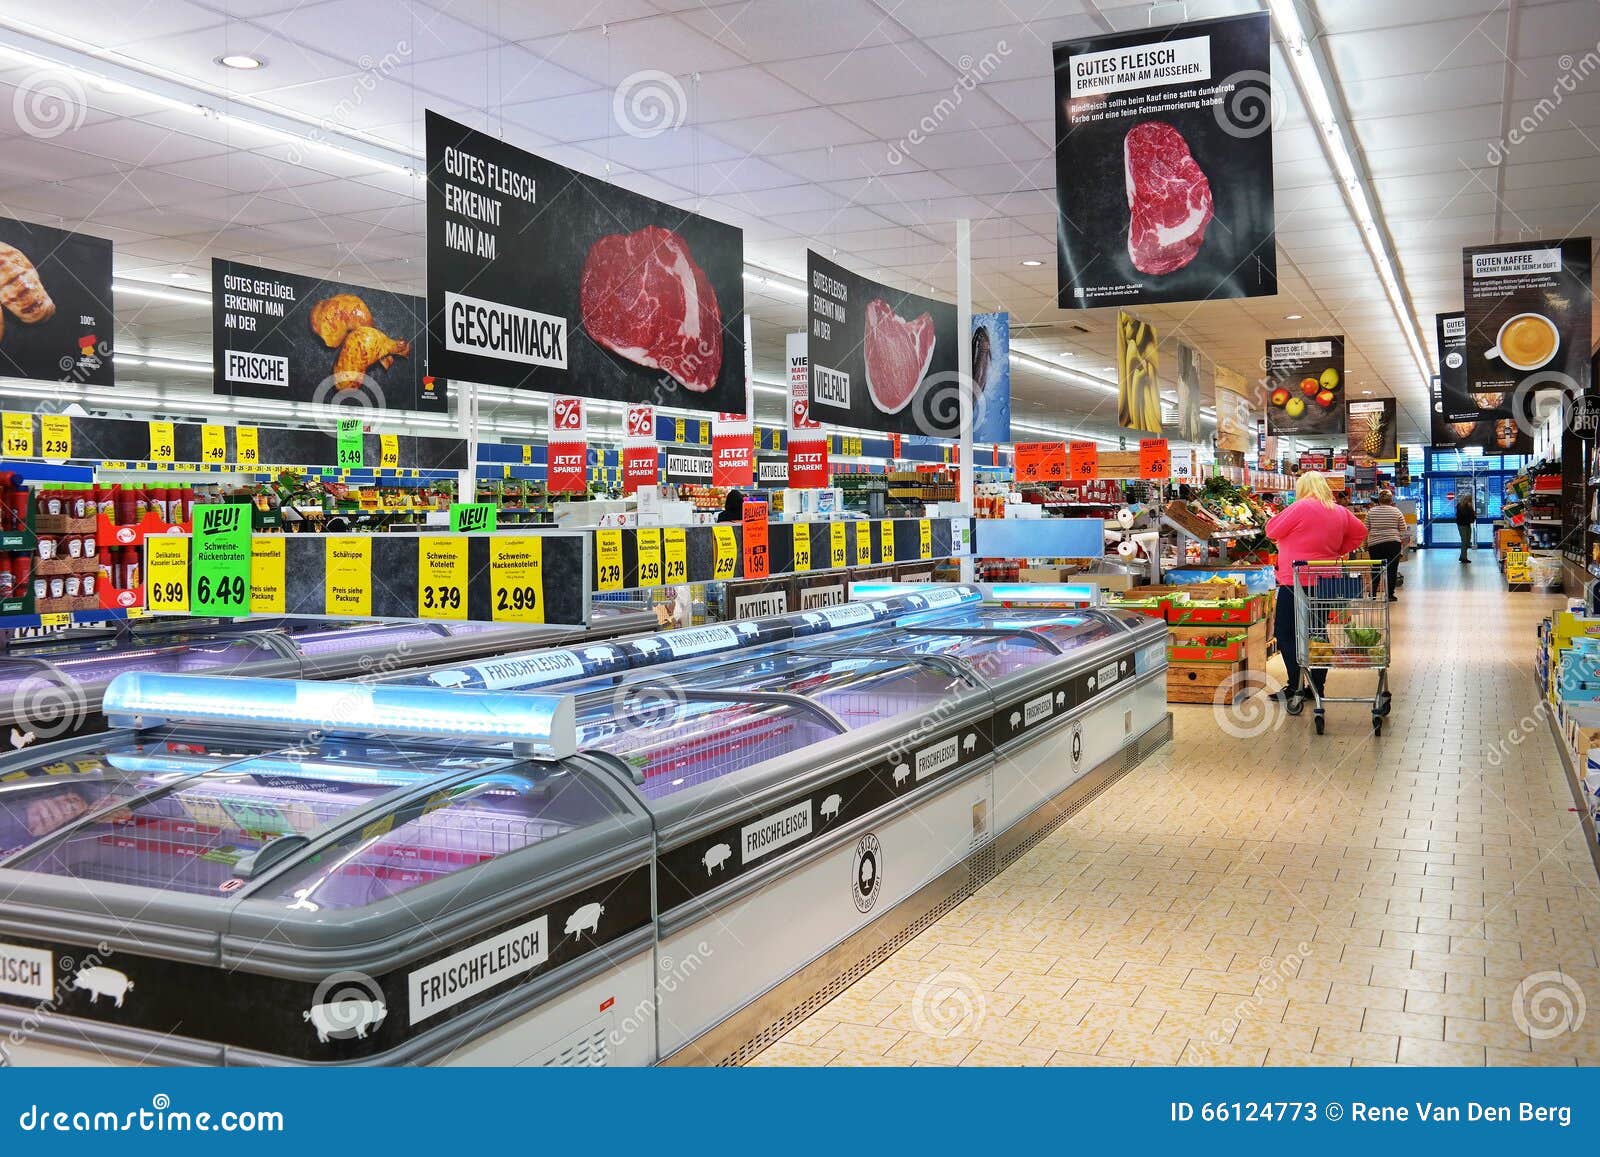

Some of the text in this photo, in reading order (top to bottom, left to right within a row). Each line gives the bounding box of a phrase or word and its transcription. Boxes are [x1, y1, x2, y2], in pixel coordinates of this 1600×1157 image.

[1077, 49, 1175, 77] GUTES FLEISCH
[1077, 63, 1203, 90] ERKENNT MAN AM AUSSEHEN.
[1109, 98, 1127, 108] sollte
[1128, 96, 1145, 105] beim
[1146, 93, 1162, 103] Kauf
[1163, 92, 1178, 100] eine
[1179, 89, 1197, 98] satte
[1071, 113, 1091, 123] Farbe
[1091, 111, 1104, 121] und
[1105, 110, 1119, 119] eine
[445, 147, 536, 204] GUTES FLEISCH
[446, 183, 501, 226] ERKENNT
[446, 221, 495, 260] MAN AM
[1476, 255, 1533, 266] GUTEN KAFFEE
[224, 274, 296, 301] GUTES GEFLÜGEL
[225, 294, 284, 317] ERKENNT MAN
[225, 315, 256, 331] AN DER
[452, 301, 563, 361] GESCHMACK
[229, 354, 285, 383] FRISCHE
[815, 369, 848, 404] VIELFALT
[8, 439, 28, 451] 1.79
[46, 440, 68, 452] 2.39
[719, 448, 749, 459] JETZT
[340, 450, 361, 464] 3.49
[553, 455, 583, 465] JETZT
[628, 458, 654, 468] JETZT
[669, 457, 698, 474] AKTUELLE
[718, 460, 749, 468] SPAREN!
[793, 453, 823, 463] JETZT
[553, 465, 582, 473] SPAREN!
[760, 465, 787, 478] AKTUELLE
[793, 463, 823, 471] SPAREN!
[203, 507, 240, 532] NEU!
[459, 506, 489, 530] NEU!
[204, 542, 239, 551] Schweine-
[333, 550, 363, 560] Schälrippe
[198, 552, 245, 561] Rückenbraten
[426, 552, 459, 561] Schweine-
[429, 560, 455, 569] Kotelett
[492, 560, 539, 569] Nackenkotelett
[498, 552, 532, 561] Schweine-
[717, 557, 734, 573] 2.59
[749, 555, 764, 573] 1.99
[795, 551, 809, 566] 2.79
[600, 565, 620, 583] 2.79
[640, 562, 659, 580] 2.59
[667, 560, 684, 578] 2.79
[153, 582, 183, 603] 6.99
[197, 575, 245, 605] 6.49
[251, 593, 274, 601] Packung
[332, 586, 363, 595] Preis siehe
[423, 585, 461, 610] 3.79
[496, 586, 536, 611] 2.99
[335, 594, 360, 604] Packung
[674, 623, 730, 648] FRISCHFLEISCH
[484, 652, 574, 681] FRISCHFLEISCH
[918, 743, 956, 771] FRISCHFLEISCH
[746, 809, 808, 854] FRISCHFLEISCH
[857, 836, 879, 860] FRISCH
[421, 931, 541, 1008] FRISCHFLEISCH
